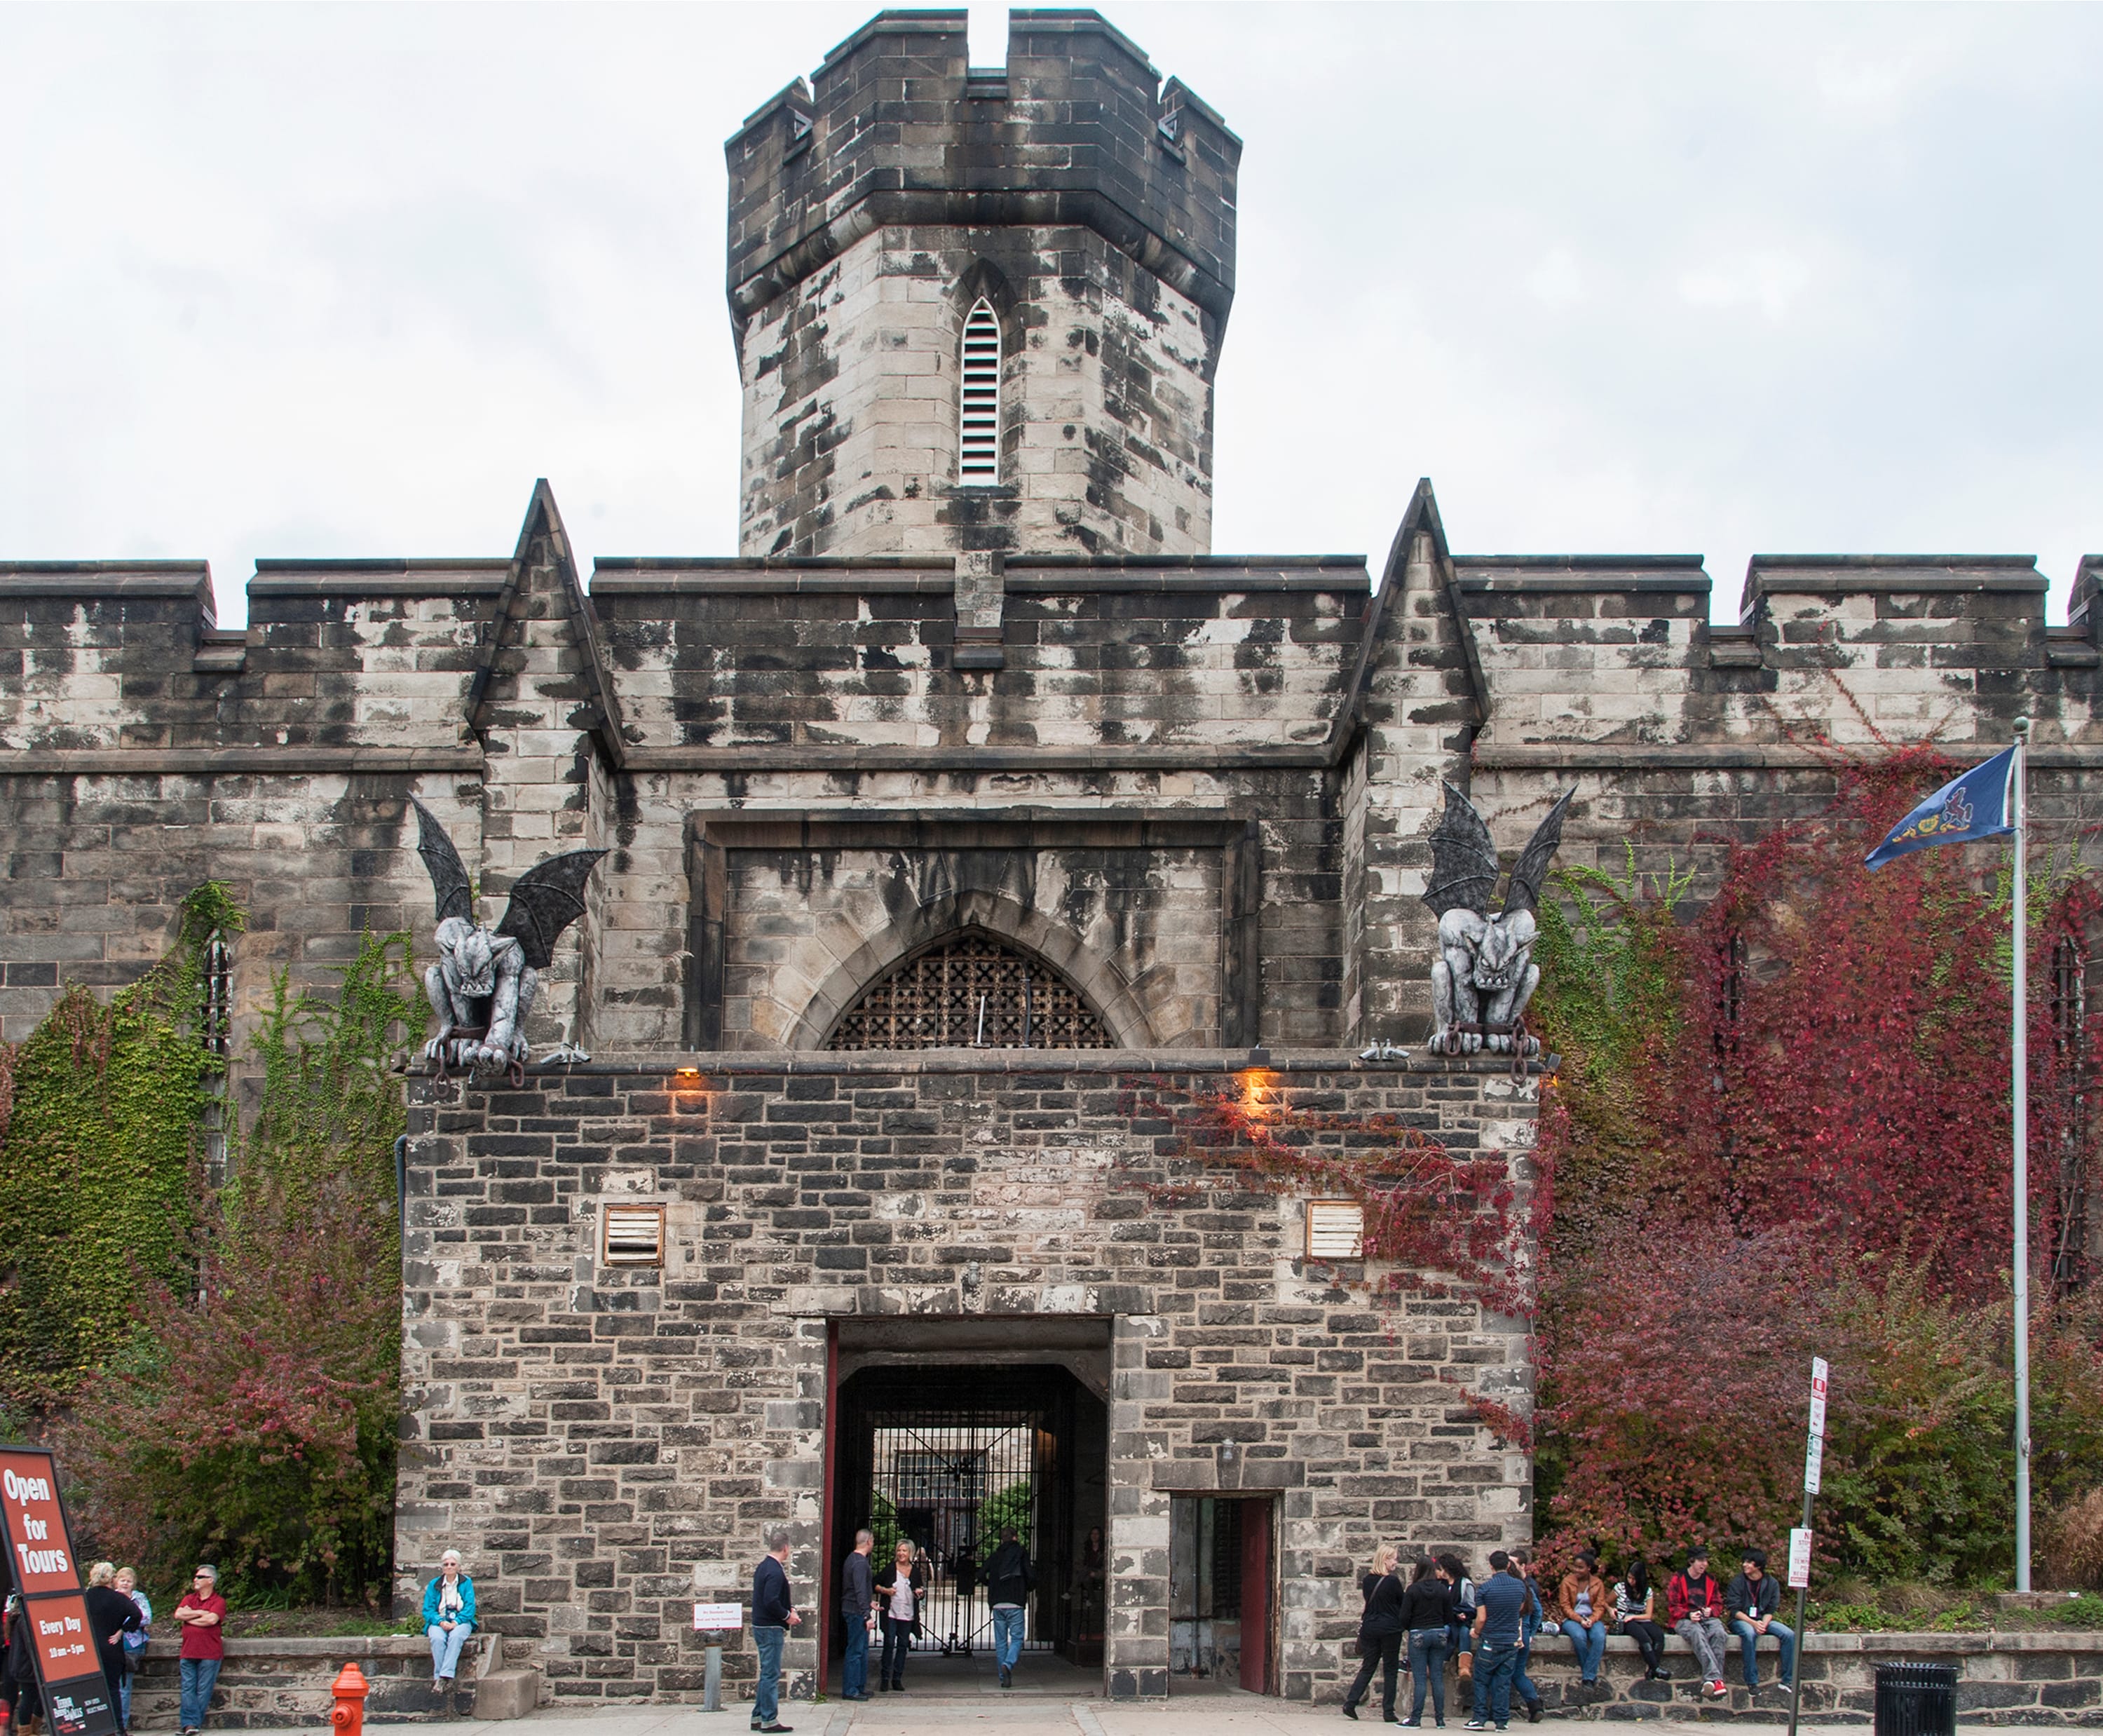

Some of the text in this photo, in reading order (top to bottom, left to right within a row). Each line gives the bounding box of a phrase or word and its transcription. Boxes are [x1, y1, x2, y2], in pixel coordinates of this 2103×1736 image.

[4, 1469, 50, 1506] Open
[23, 1514, 48, 1540] for
[17, 1544, 68, 1574] Tours
[39, 1616, 81, 1636] Every Day
